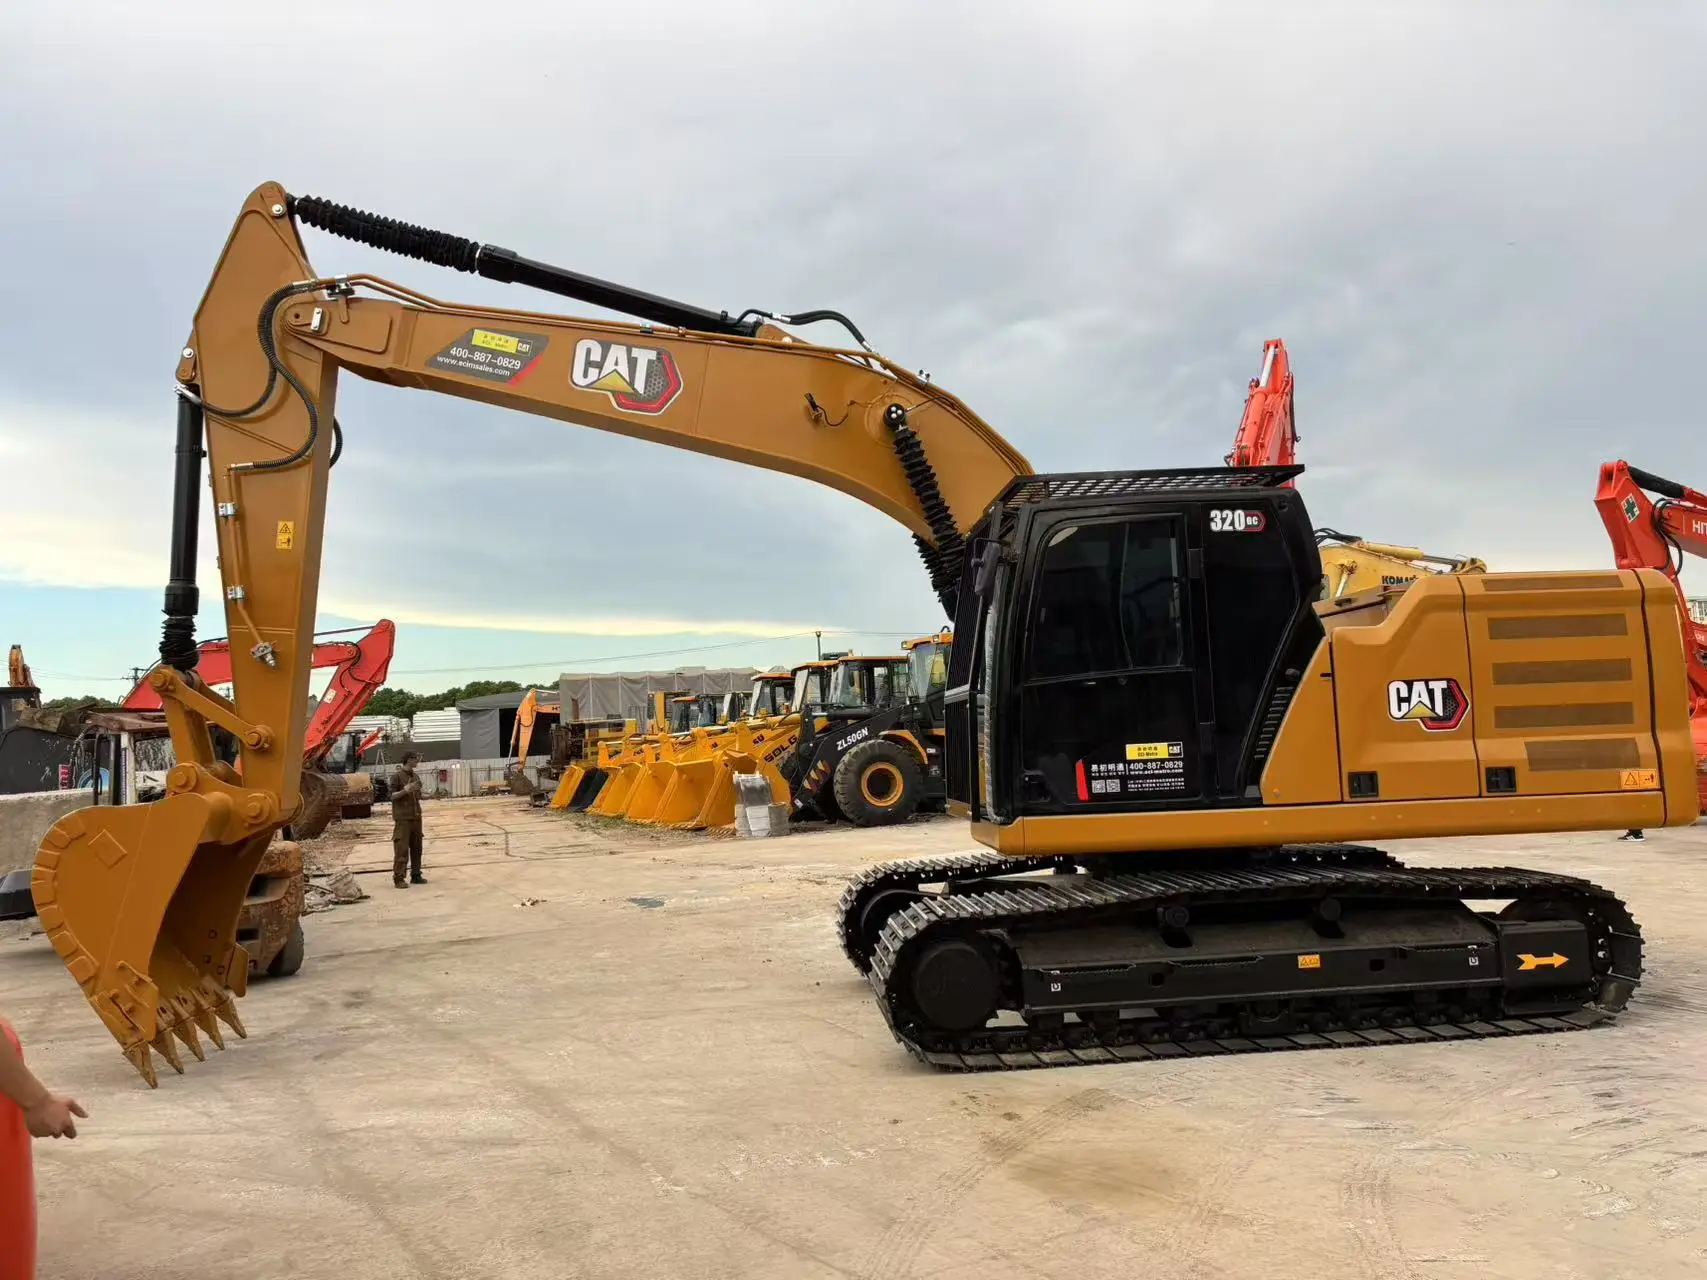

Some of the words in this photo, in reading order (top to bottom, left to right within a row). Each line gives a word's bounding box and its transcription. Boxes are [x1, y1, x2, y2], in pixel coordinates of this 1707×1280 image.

[450, 347, 521, 370] 400-887-0829
[517, 342, 530, 353] CAT
[437, 356, 510, 376] www.ecimsales.com
[571, 339, 657, 394] CAT
[1210, 509, 1246, 532] 320
[1389, 680, 1448, 718] CAT
[836, 726, 869, 751] ZL50GN
[1168, 745, 1181, 754] CAT
[1129, 761, 1183, 770] 400-887-0829
